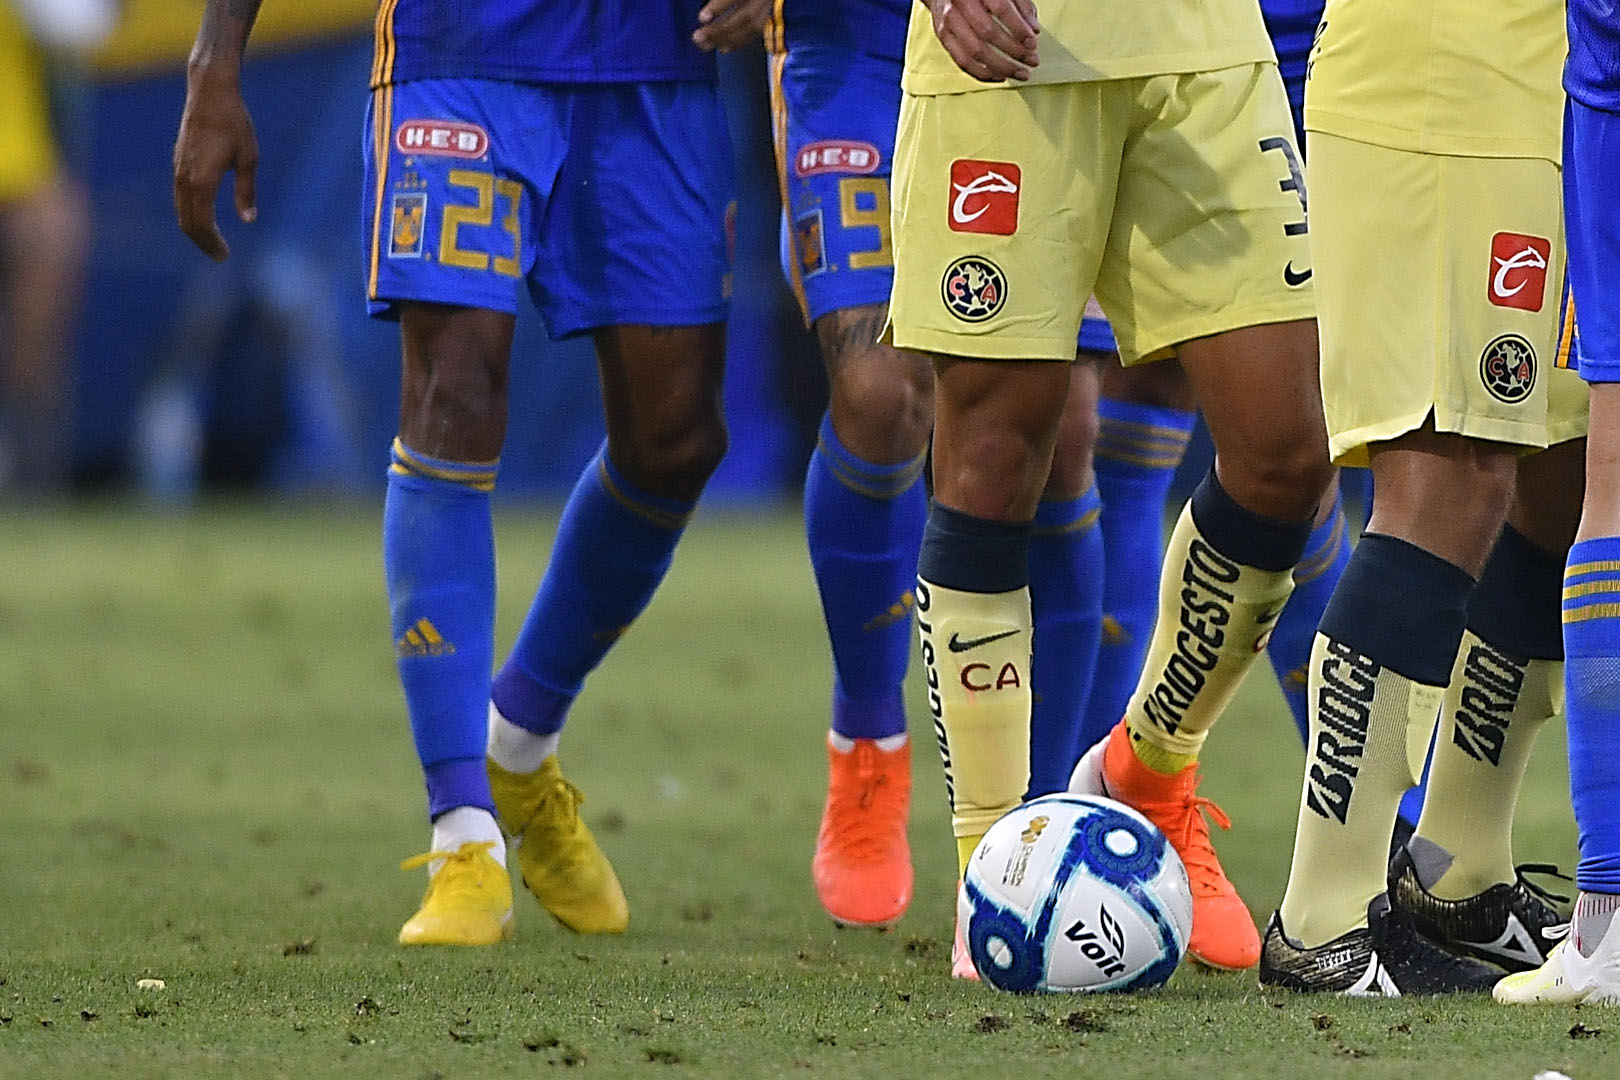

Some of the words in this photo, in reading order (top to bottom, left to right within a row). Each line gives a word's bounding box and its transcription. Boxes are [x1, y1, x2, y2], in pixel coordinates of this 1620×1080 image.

[439, 170, 523, 279] 23
[840, 177, 894, 269] 9
[961, 662, 1020, 692] CA
[1144, 538, 1241, 736] BRIDGESTO
[1064, 920, 1127, 978] Voit
